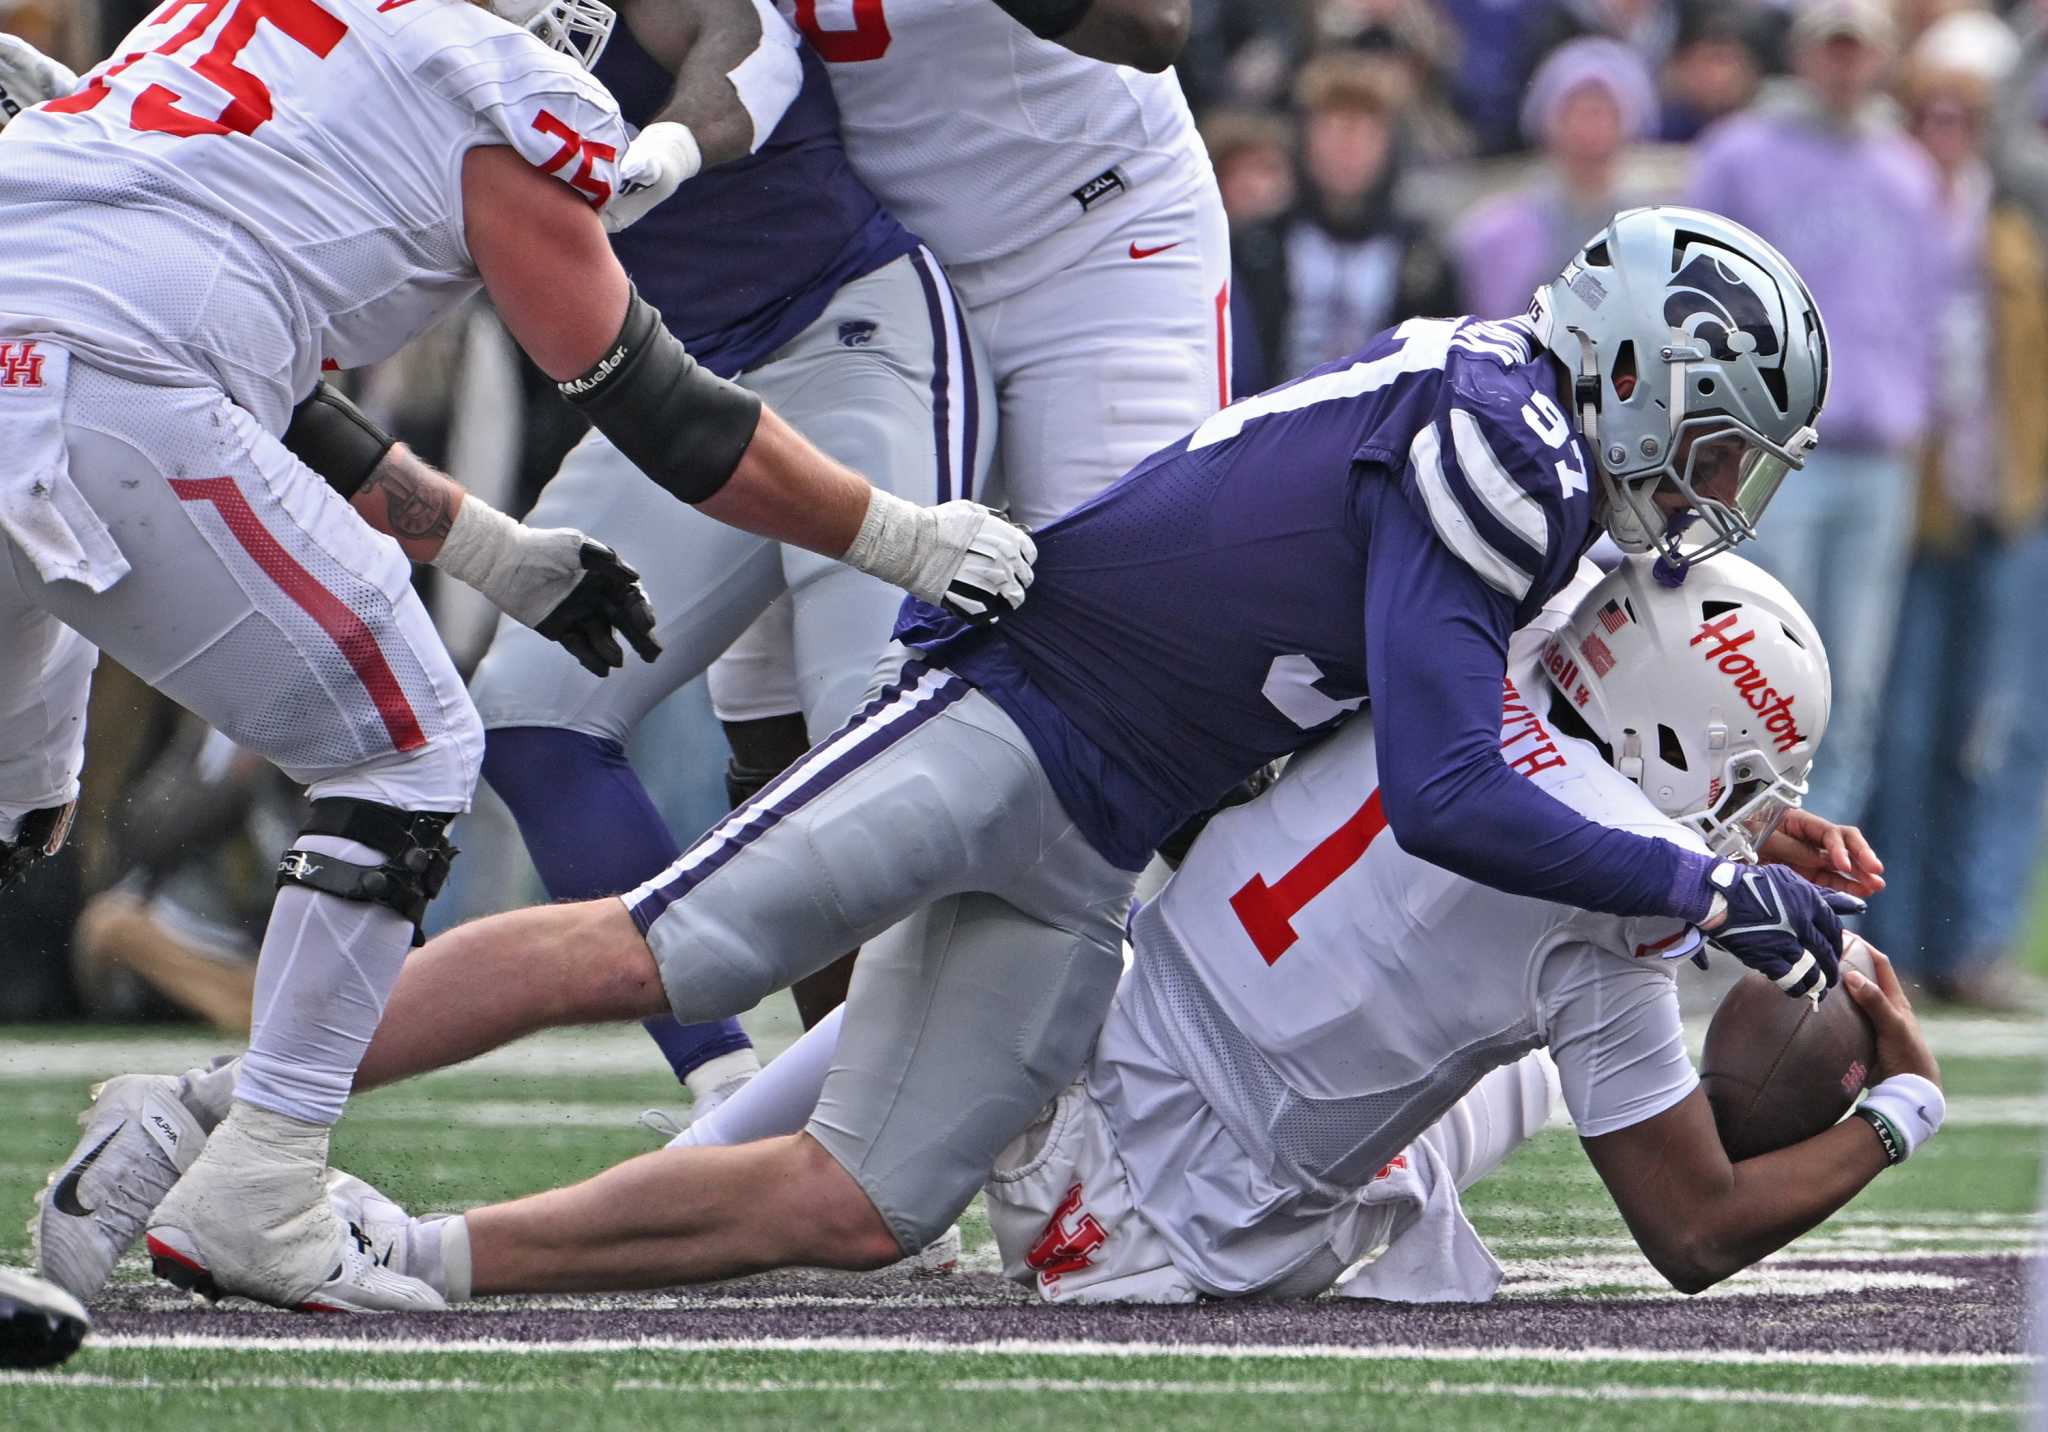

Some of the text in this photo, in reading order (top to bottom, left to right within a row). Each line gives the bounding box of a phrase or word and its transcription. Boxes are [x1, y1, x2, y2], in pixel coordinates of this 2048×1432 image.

[531, 109, 617, 211] 75
[1081, 177, 1115, 200] 2XL
[1520, 389, 1589, 500] 97
[1690, 613, 1808, 753] Houston
[1230, 786, 1388, 967] 1
[150, 1115, 178, 1146] ALPHA
